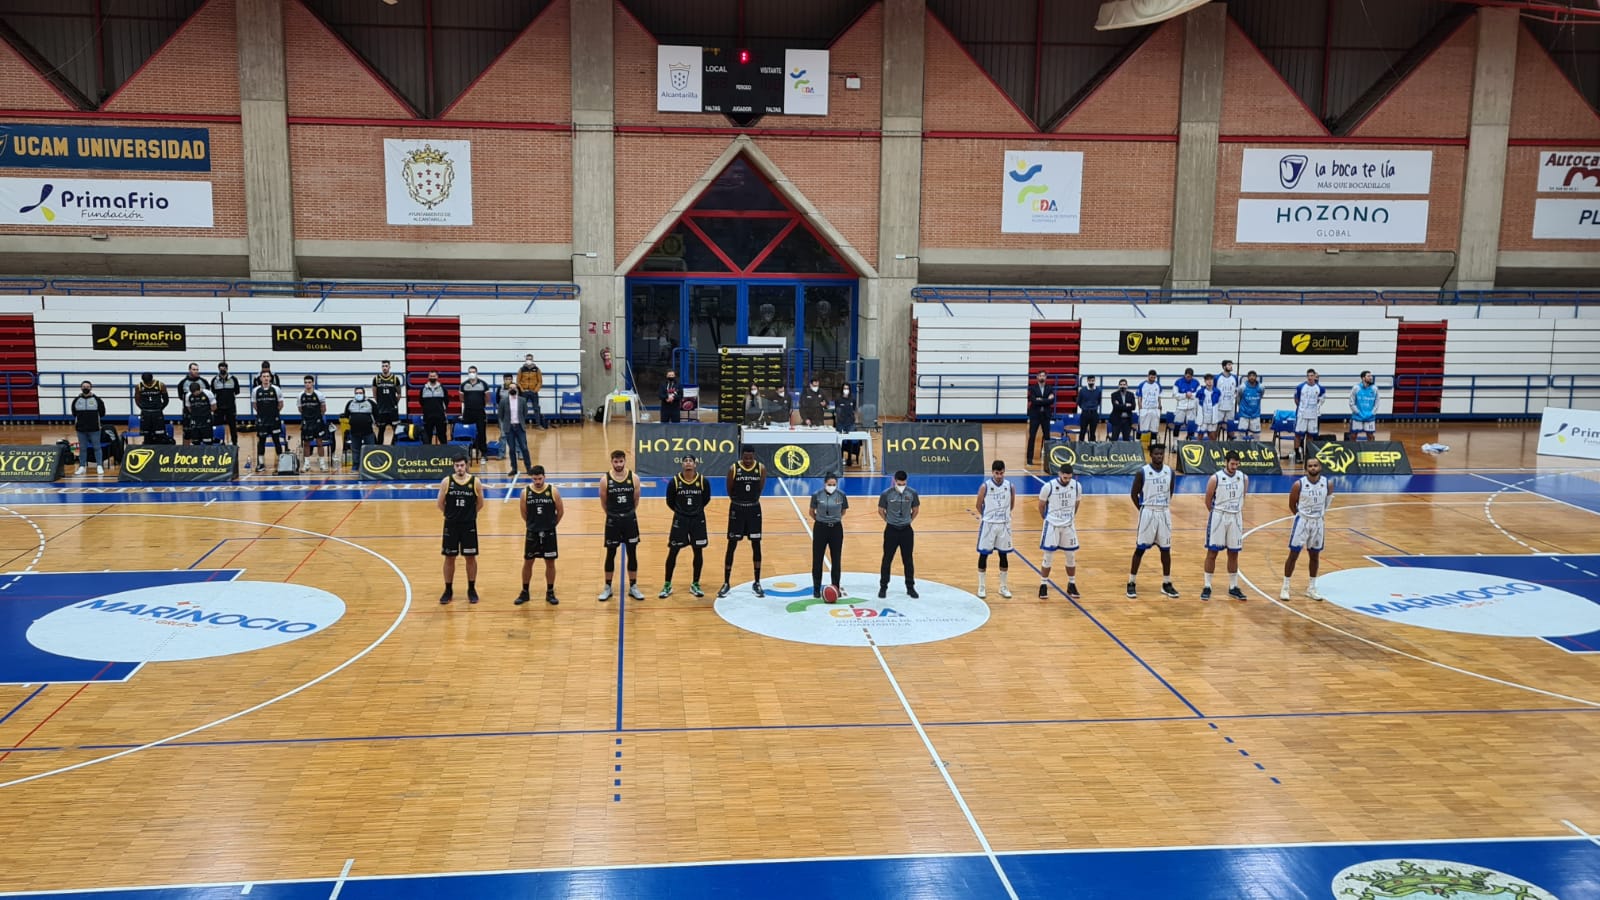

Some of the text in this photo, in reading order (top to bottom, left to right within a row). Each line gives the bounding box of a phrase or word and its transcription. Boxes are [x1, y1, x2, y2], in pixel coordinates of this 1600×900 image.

[705, 65, 727, 73] LOCAL
[14, 135, 206, 160] UCAM UNIVERSIDAD
[1315, 160, 1395, 178] la boca te lía
[81, 209, 144, 219] Fundación
[1276, 205, 1389, 224] HOZONO
[276, 328, 358, 341] HOZONO
[1312, 336, 1348, 348] adimul
[638, 438, 735, 454] HOZONO
[886, 436, 980, 452] HOZONO
[159, 452, 232, 466] la boca te lía
[1081, 453, 1142, 462] Costa Cálida
[1210, 448, 1220, 460] la
[398, 458, 428, 466] Costa
[1352, 582, 1542, 614] MARINOCIO
[76, 600, 318, 632] MARINOCIO
